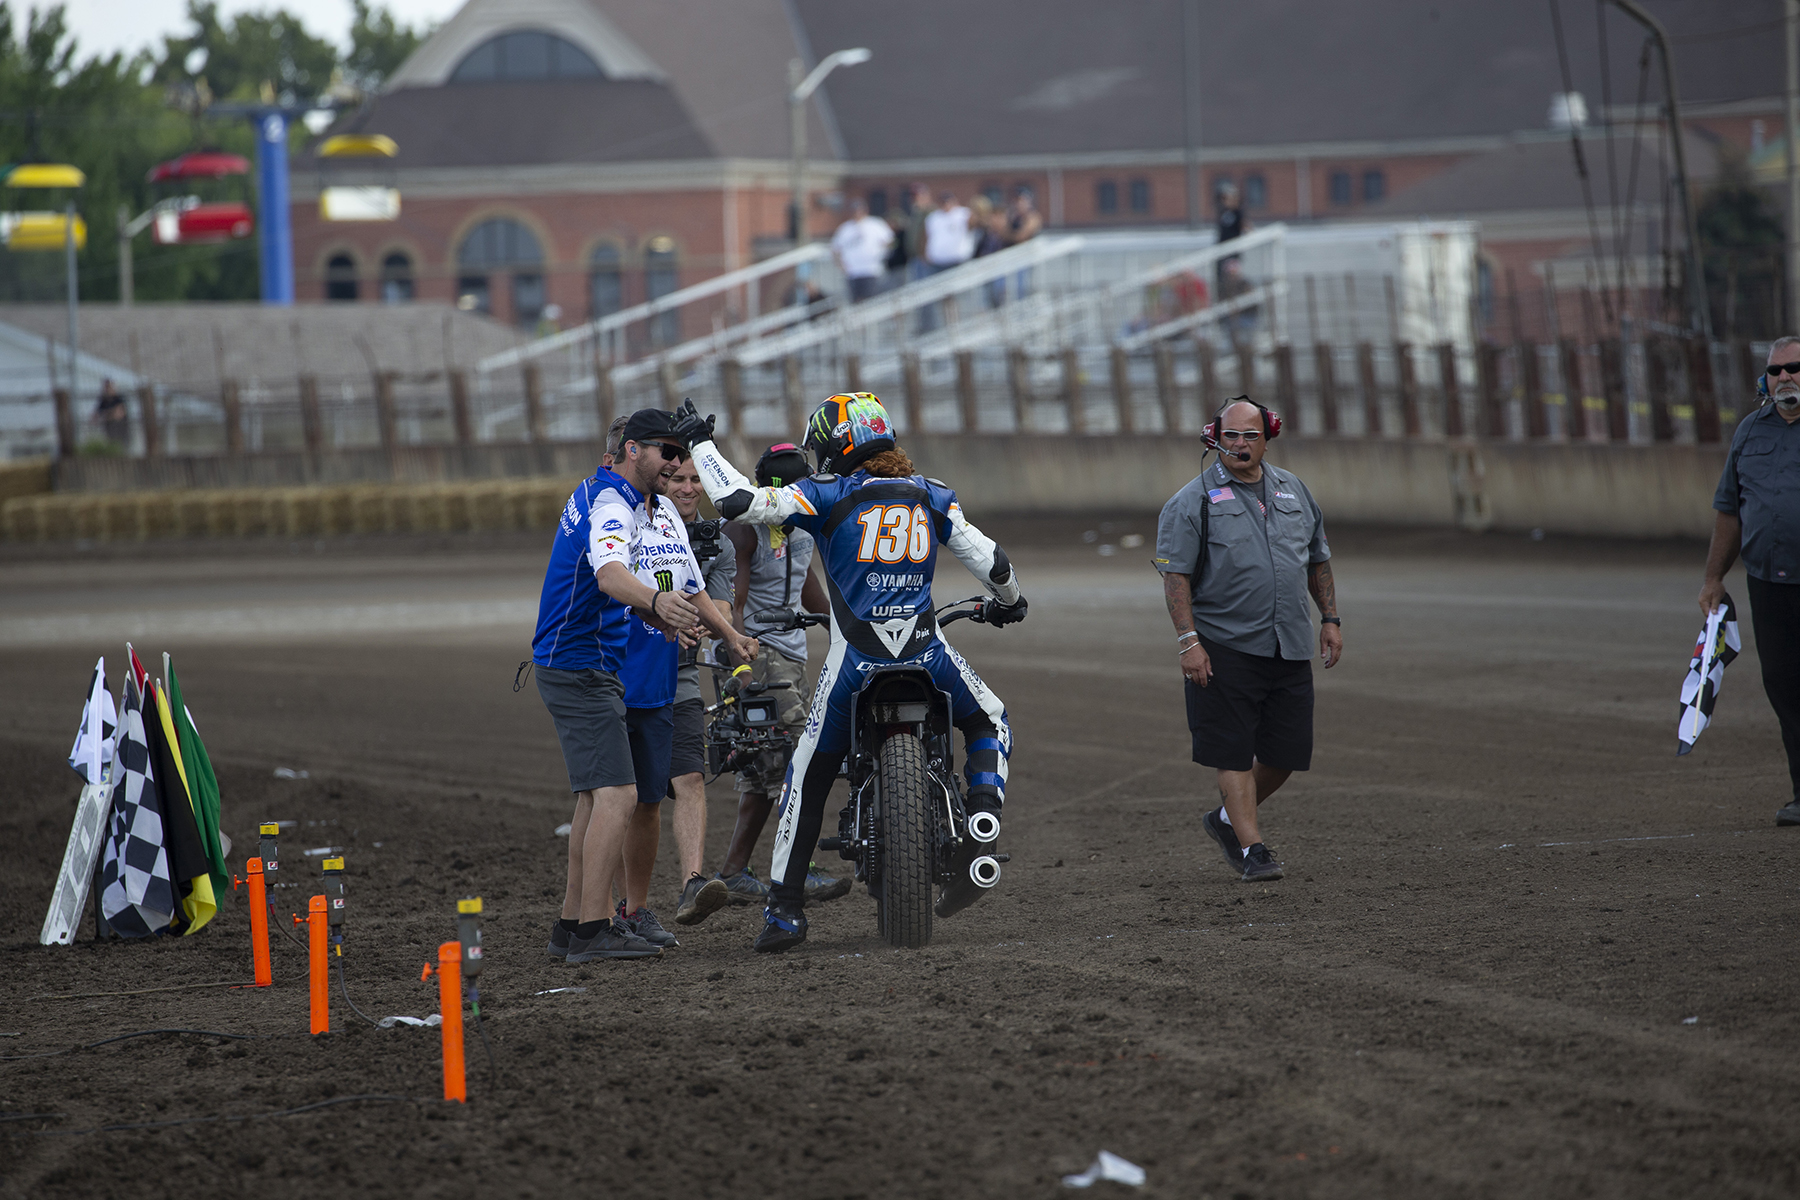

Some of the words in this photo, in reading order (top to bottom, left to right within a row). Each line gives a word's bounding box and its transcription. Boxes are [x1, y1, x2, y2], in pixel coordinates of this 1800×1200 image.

[705, 453, 730, 487] ESTENSON
[857, 503, 931, 564] 136
[652, 557, 689, 568] Racing
[881, 574, 924, 587] YAMAHA
[872, 604, 916, 617] WPS
